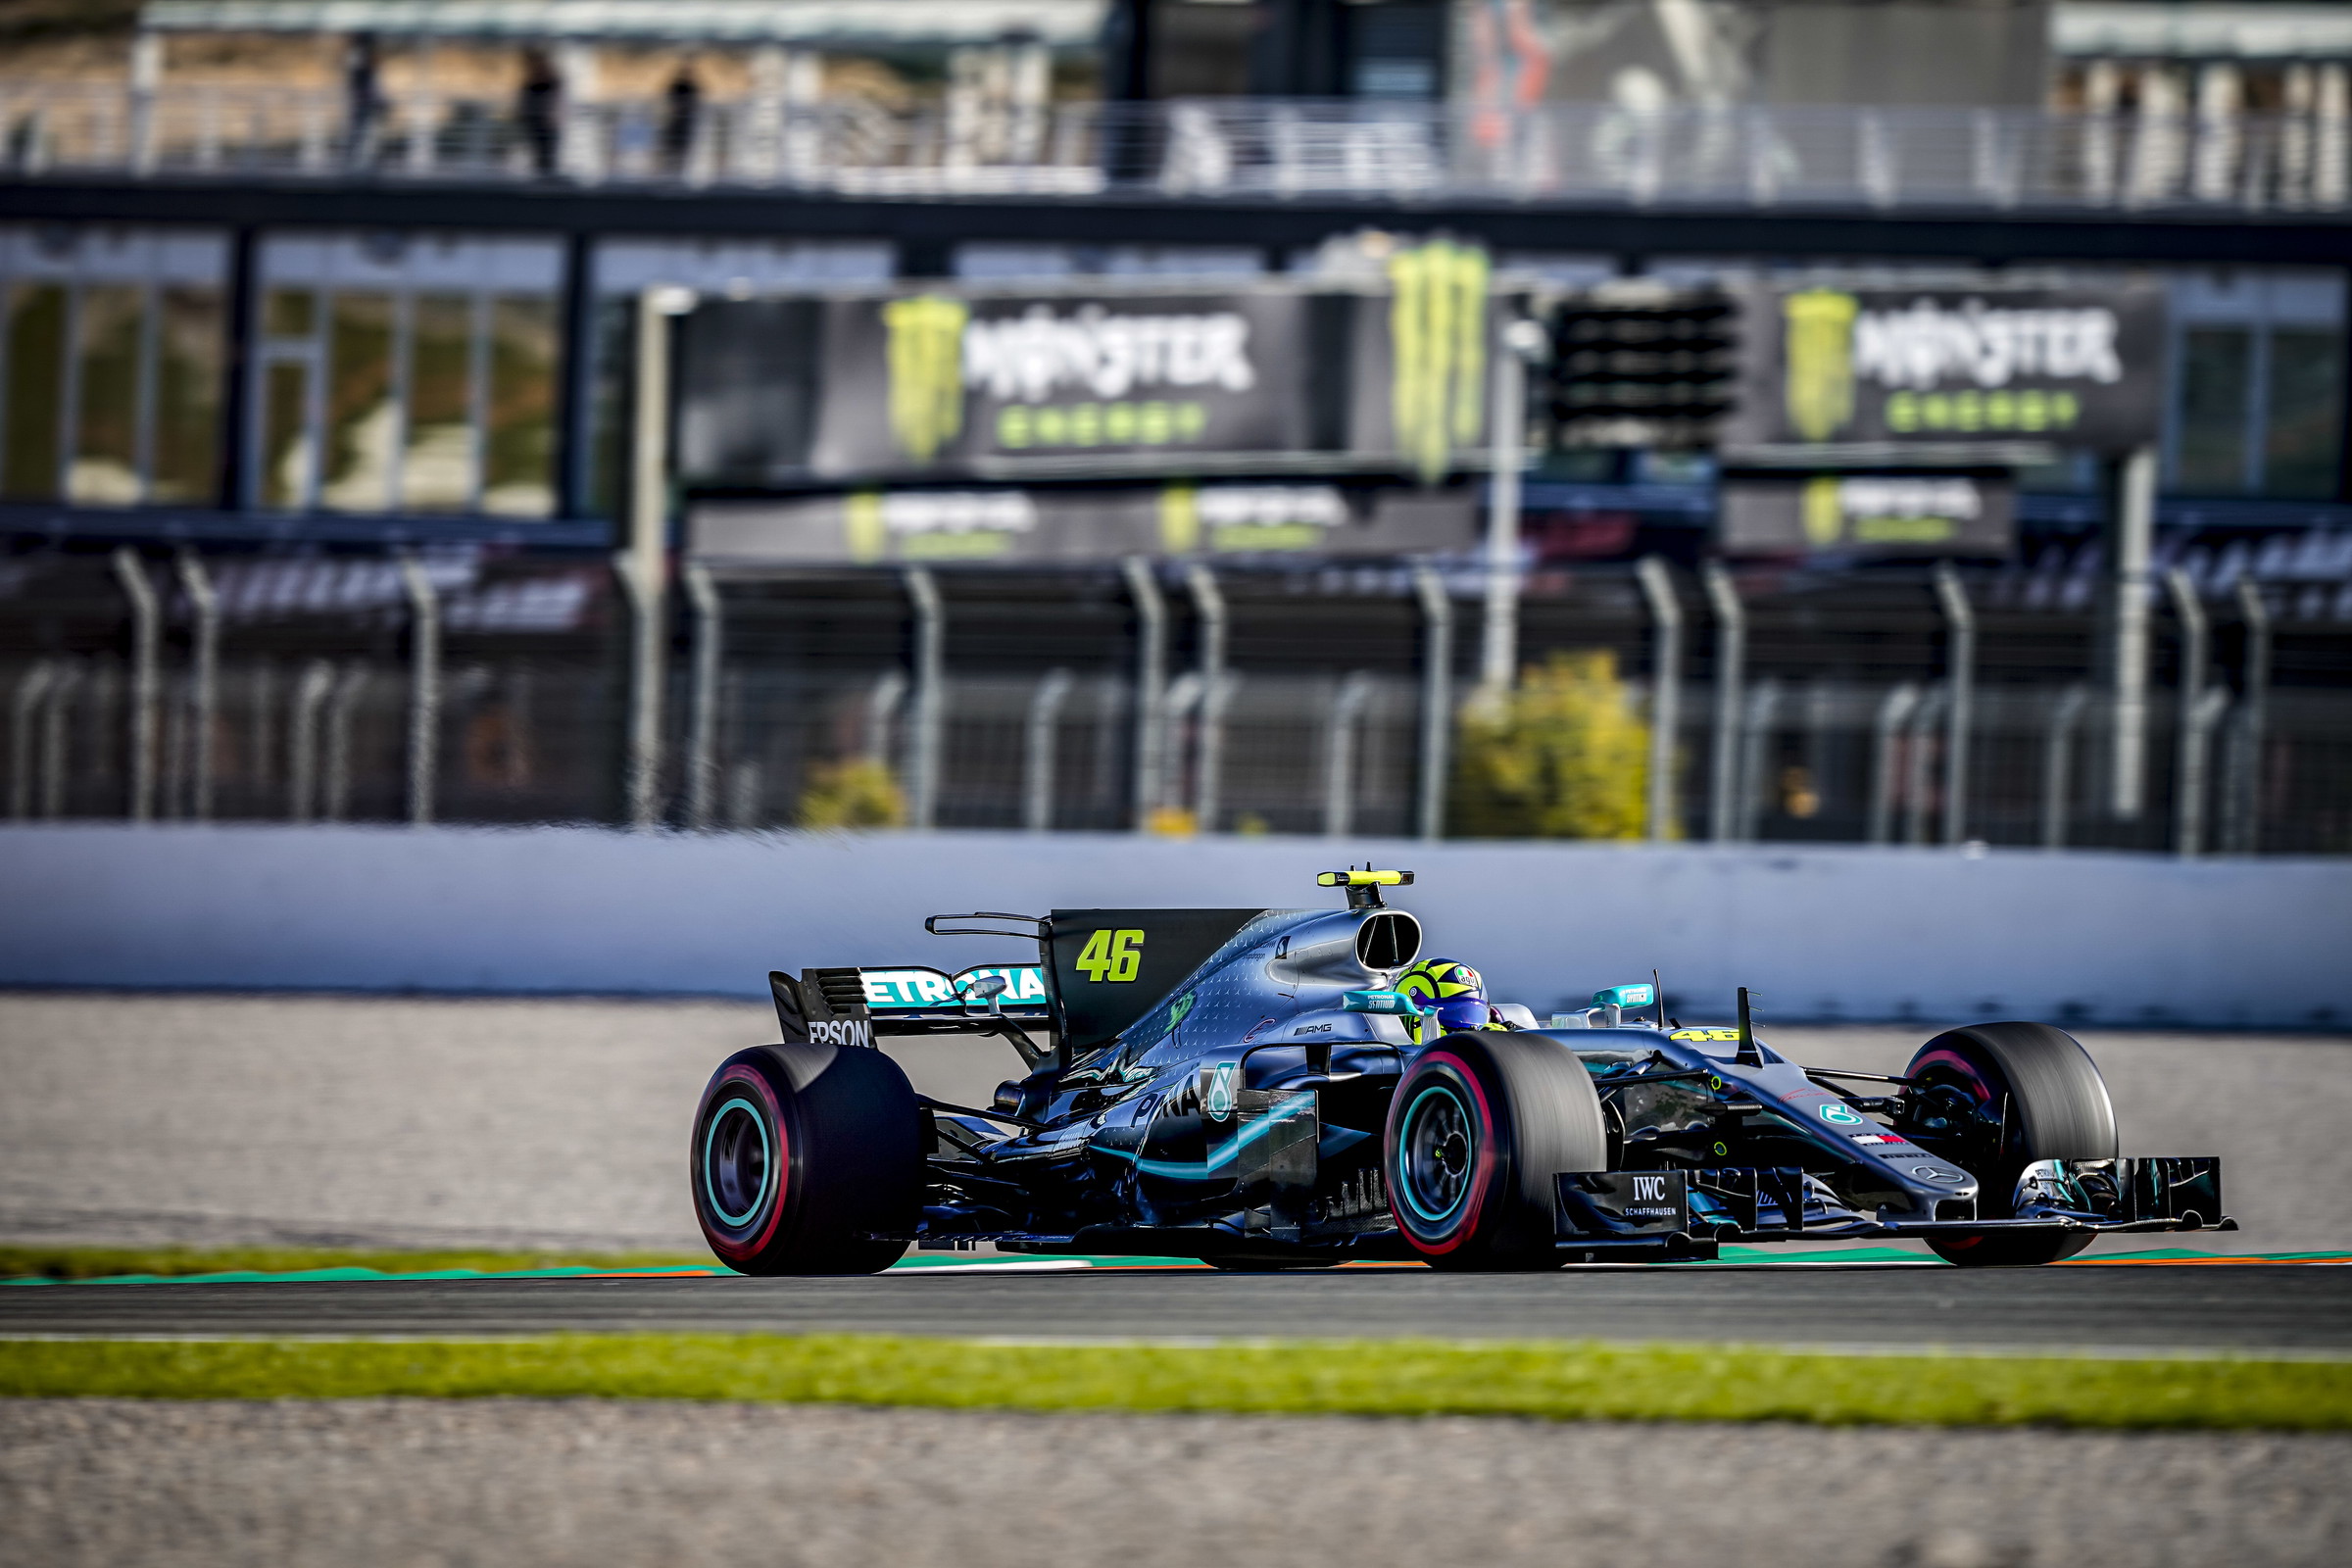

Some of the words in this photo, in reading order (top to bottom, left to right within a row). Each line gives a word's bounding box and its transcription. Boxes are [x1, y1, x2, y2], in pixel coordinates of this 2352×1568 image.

[962, 305, 1254, 401] MONSTER
[1853, 299, 2122, 387] MONSTER
[997, 402, 1205, 448] ENERGY
[1886, 390, 2081, 434] ENERGY
[1075, 928, 1145, 982] 46
[860, 968, 1046, 1003] ETRONA
[808, 1019, 869, 1049] EPSON
[1304, 1023, 1333, 1035] AMG
[1669, 1029, 1740, 1042] 46
[1633, 1176, 1666, 1201] IWC
[1625, 1206, 1677, 1217] SCHAFFHAUSEN
